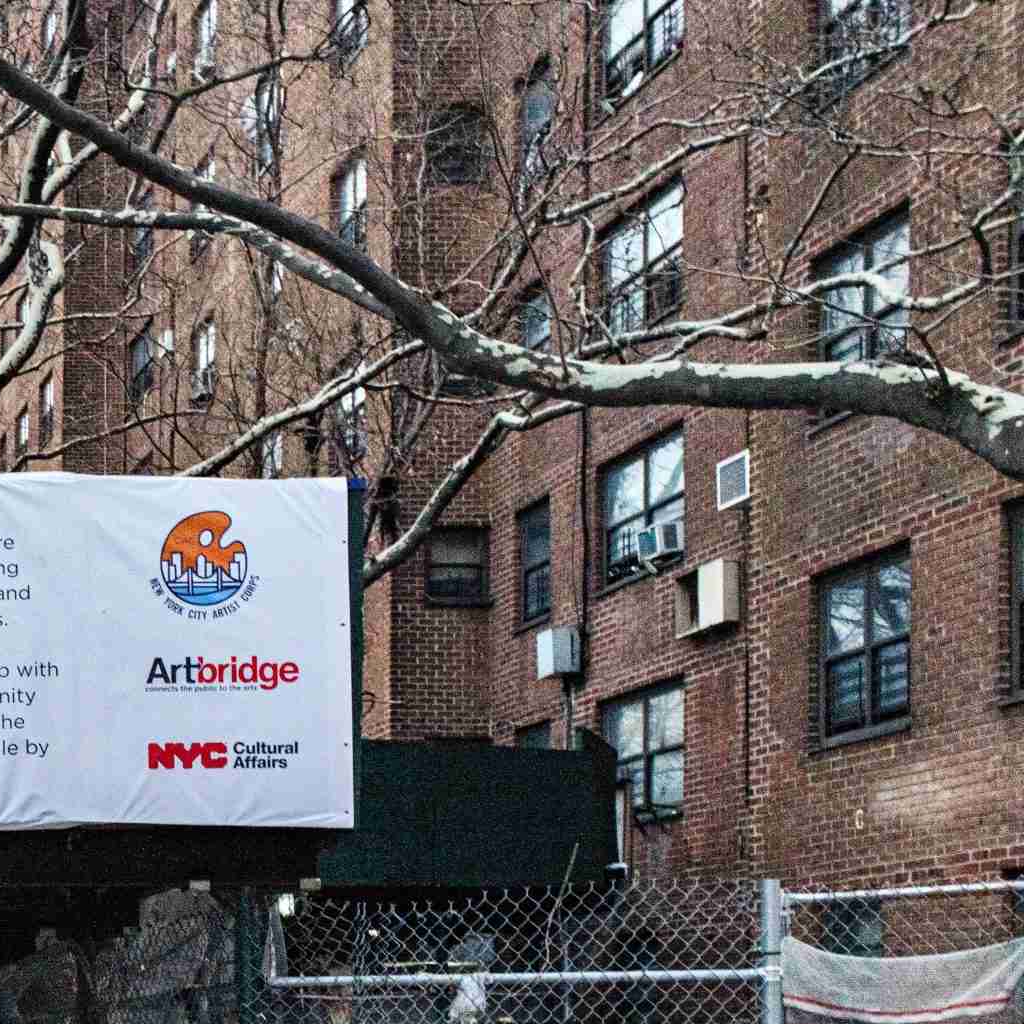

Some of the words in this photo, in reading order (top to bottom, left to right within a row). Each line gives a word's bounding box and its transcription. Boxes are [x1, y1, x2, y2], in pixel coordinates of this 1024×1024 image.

[164, 597, 184, 616] YORK
[188, 609, 208, 620] CITY
[213, 601, 240, 619] ARTIST
[240, 575, 260, 602] CORPS
[16, 660, 59, 678] with
[146, 655, 300, 690] Artbridge
[25, 738, 50, 759] by
[147, 741, 227, 769] NYC
[233, 741, 299, 755] Cultural
[233, 755, 288, 770] Affairs
